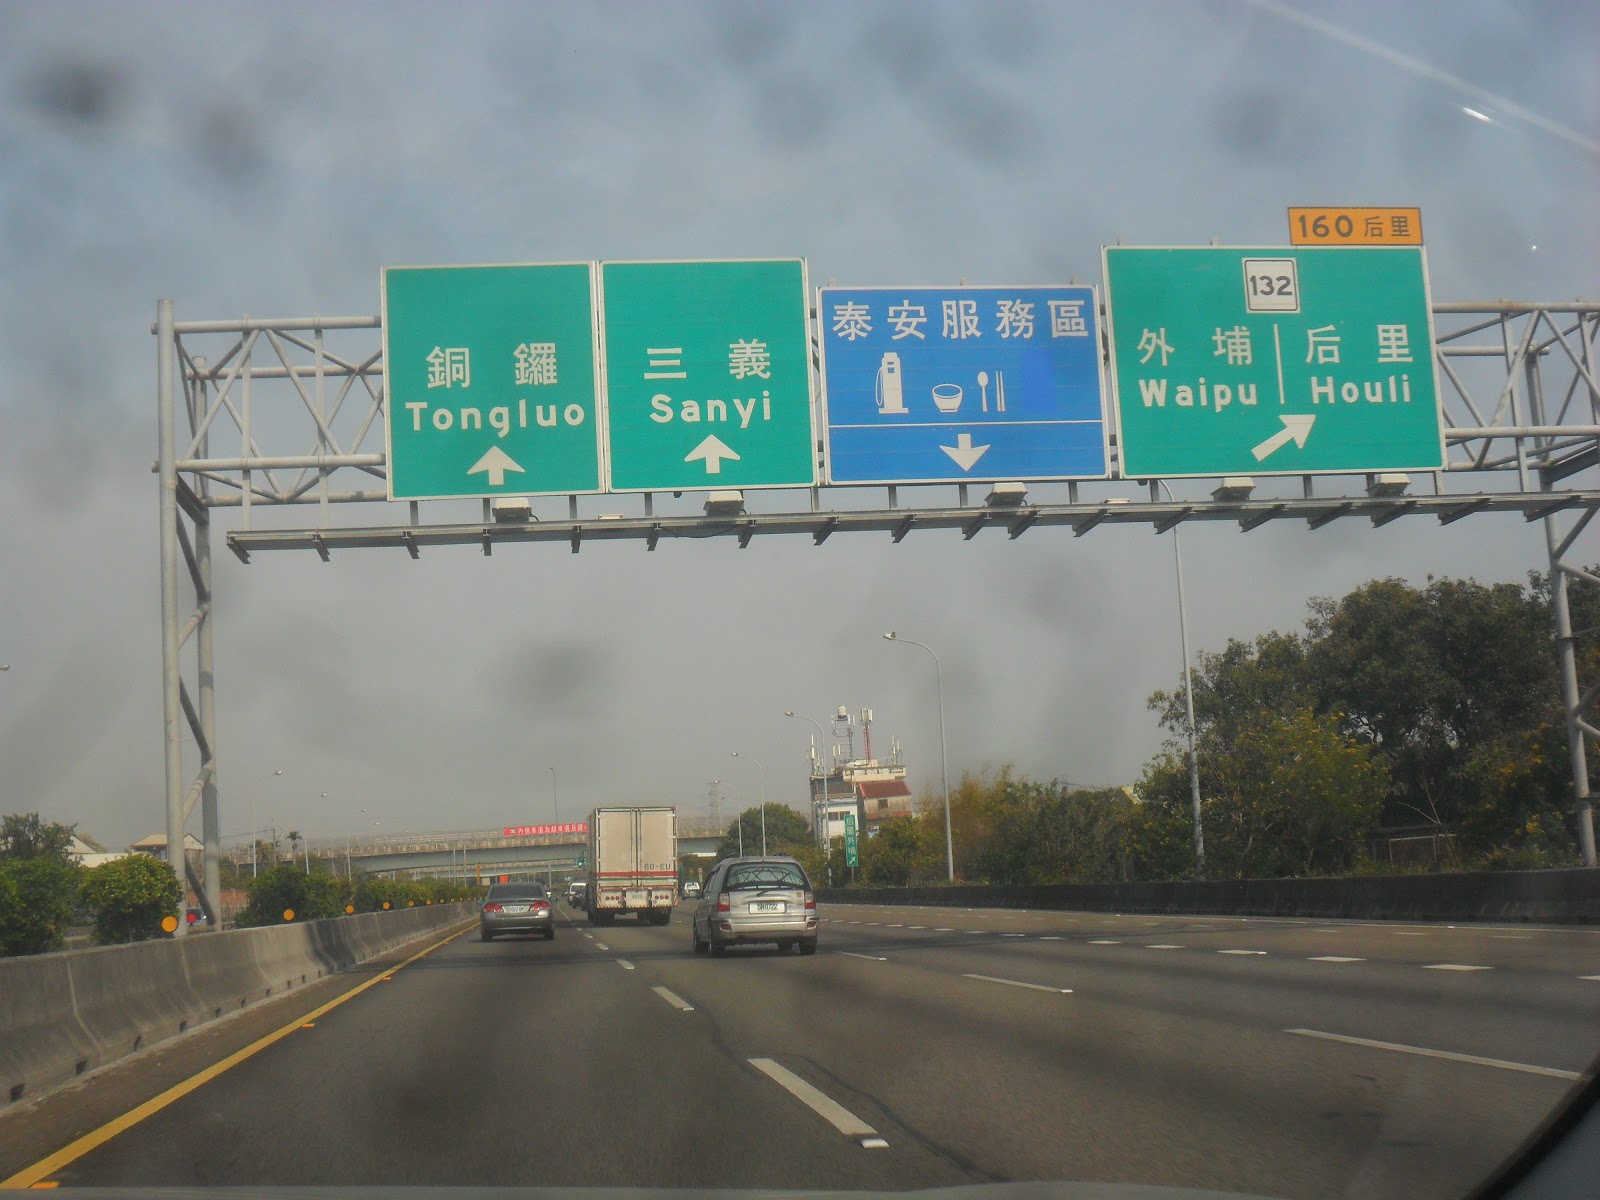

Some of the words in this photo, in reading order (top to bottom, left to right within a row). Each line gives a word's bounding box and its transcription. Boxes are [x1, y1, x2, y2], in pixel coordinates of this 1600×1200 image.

[1298, 214, 1354, 238] 160
[1364, 215, 1411, 238] 后里
[1249, 274, 1293, 297] 132
[832, 298, 1089, 342] 泰安服務區
[643, 337, 772, 381] 三義
[1136, 325, 1253, 367] 外埔
[1305, 323, 1414, 364] 后里
[425, 341, 559, 390] 銅鑼
[649, 389, 772, 429] Sanyi
[1138, 376, 1258, 413] Waipu
[1310, 373, 1412, 405] Houli
[404, 398, 586, 438] Tongluo
